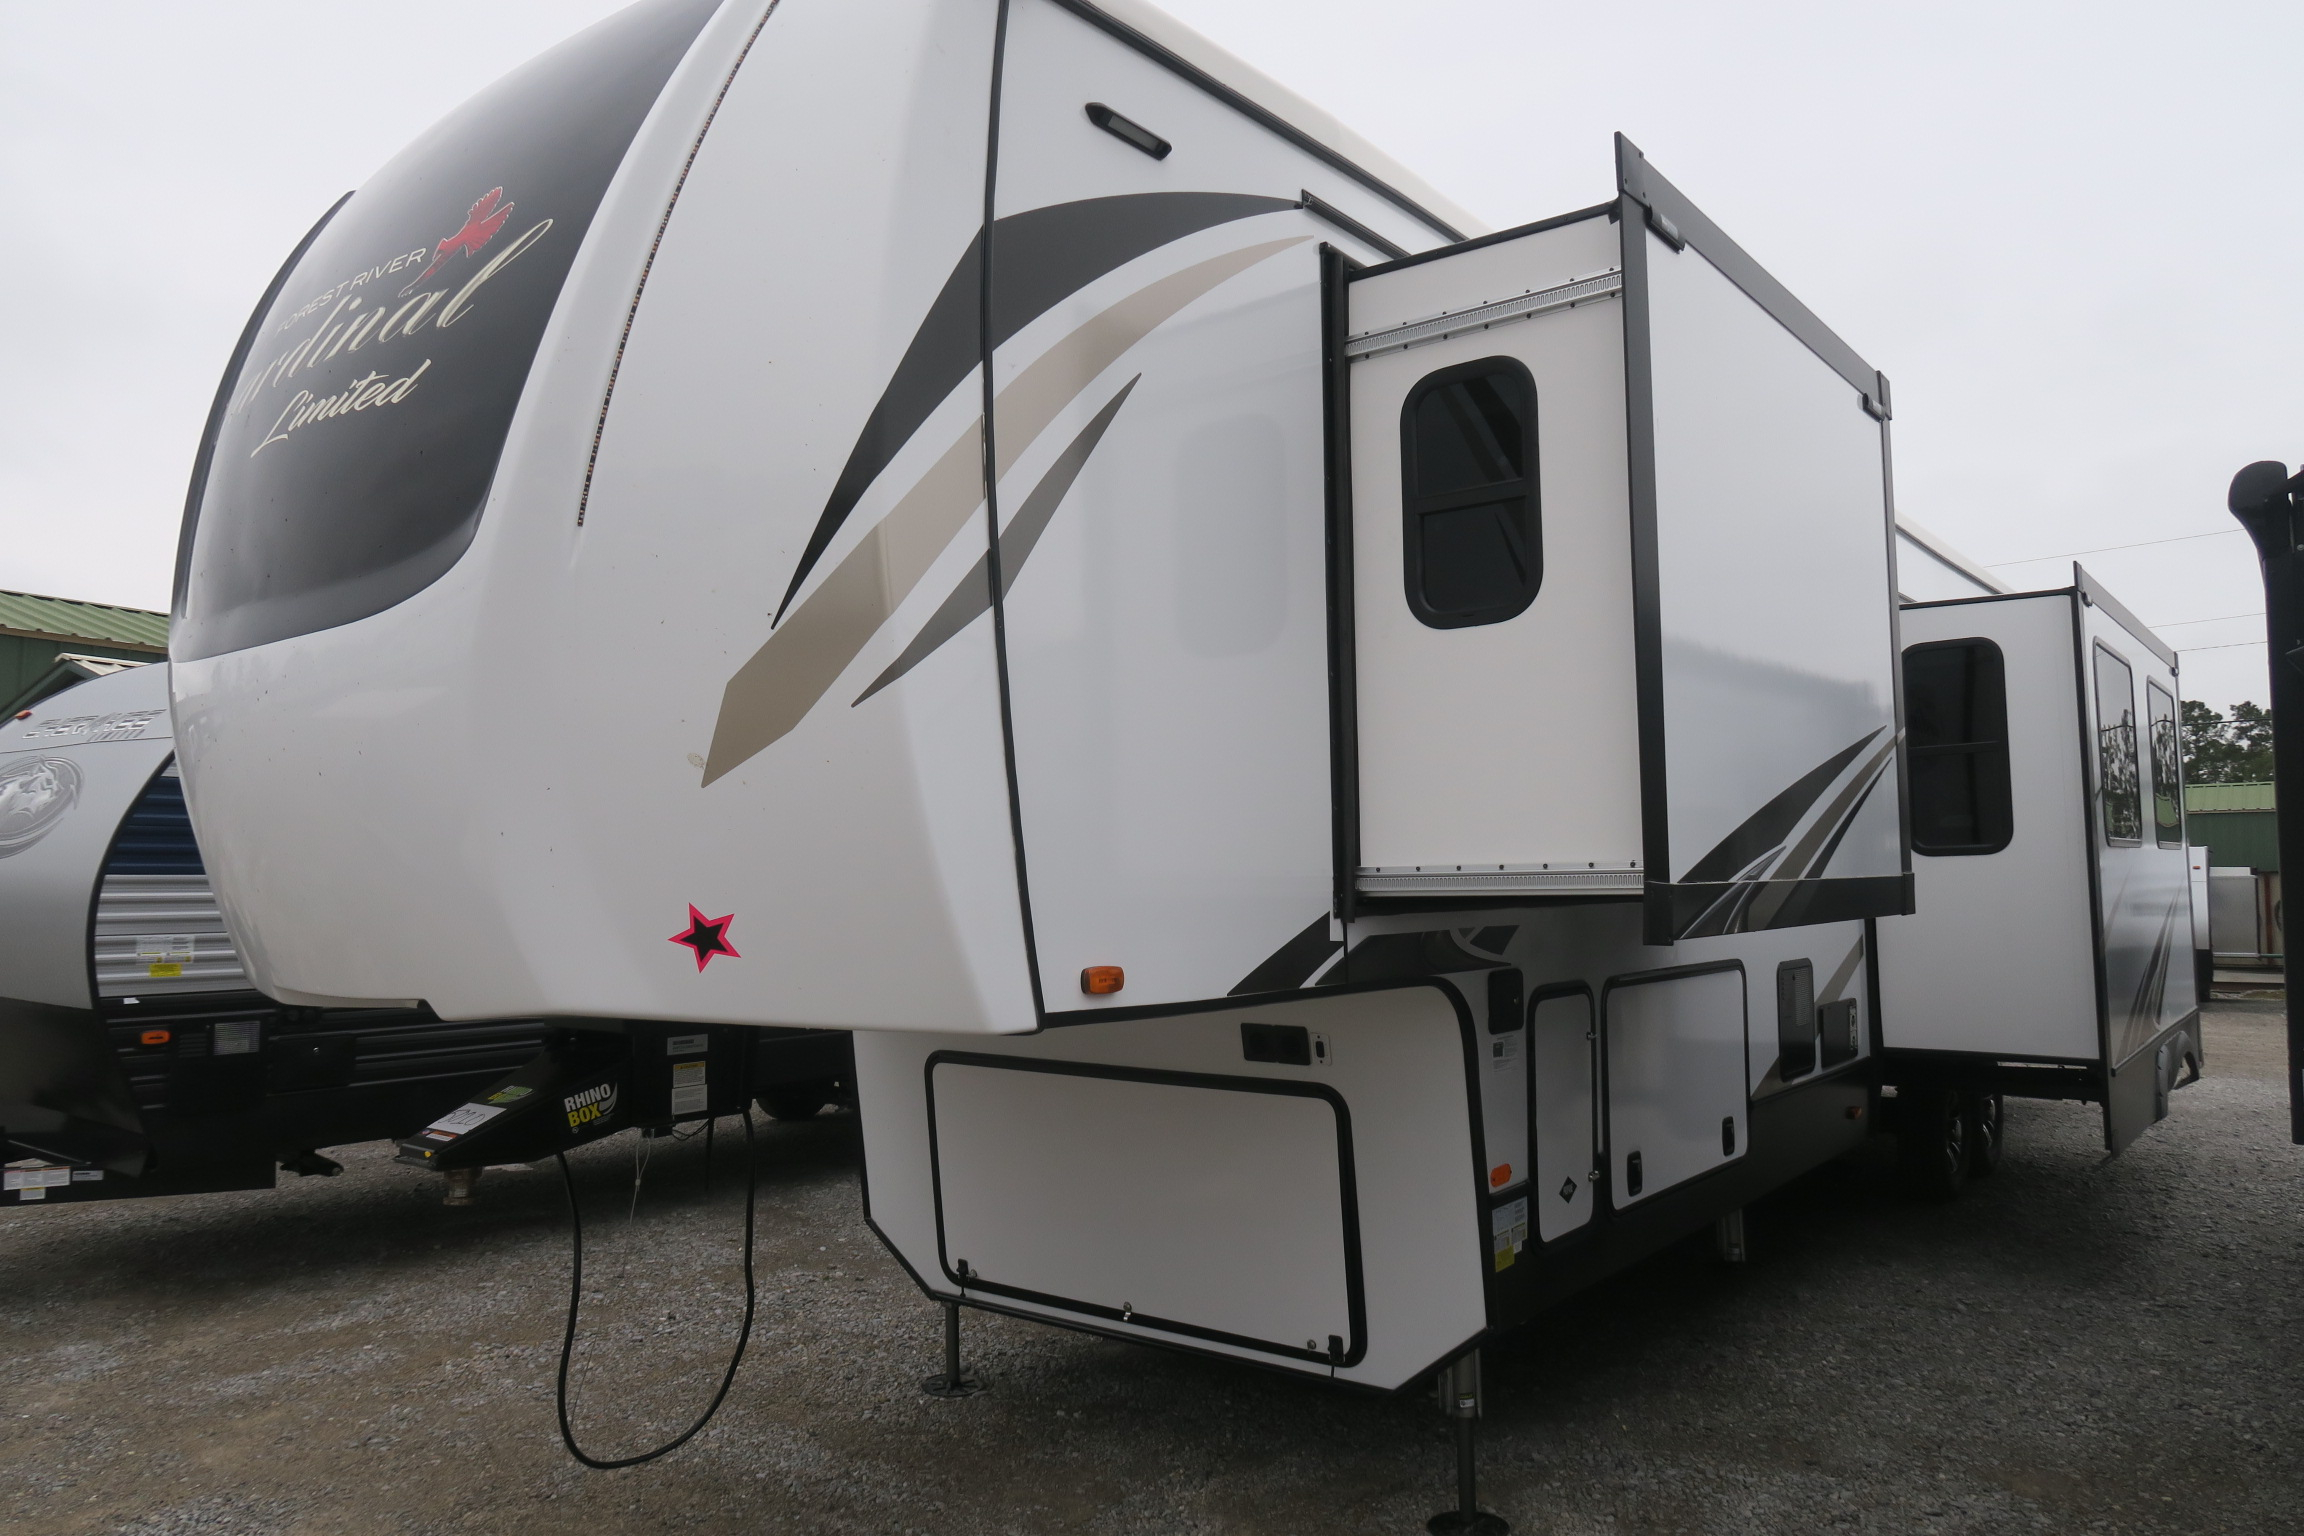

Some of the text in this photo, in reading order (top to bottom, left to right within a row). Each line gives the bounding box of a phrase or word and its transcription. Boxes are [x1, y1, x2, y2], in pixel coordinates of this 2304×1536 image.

[350, 247, 428, 291] RIVER
[231, 218, 554, 415] ardinal
[250, 358, 432, 458] Limited
[563, 1083, 612, 1113] RHINO
[567, 1102, 603, 1128] BOX
